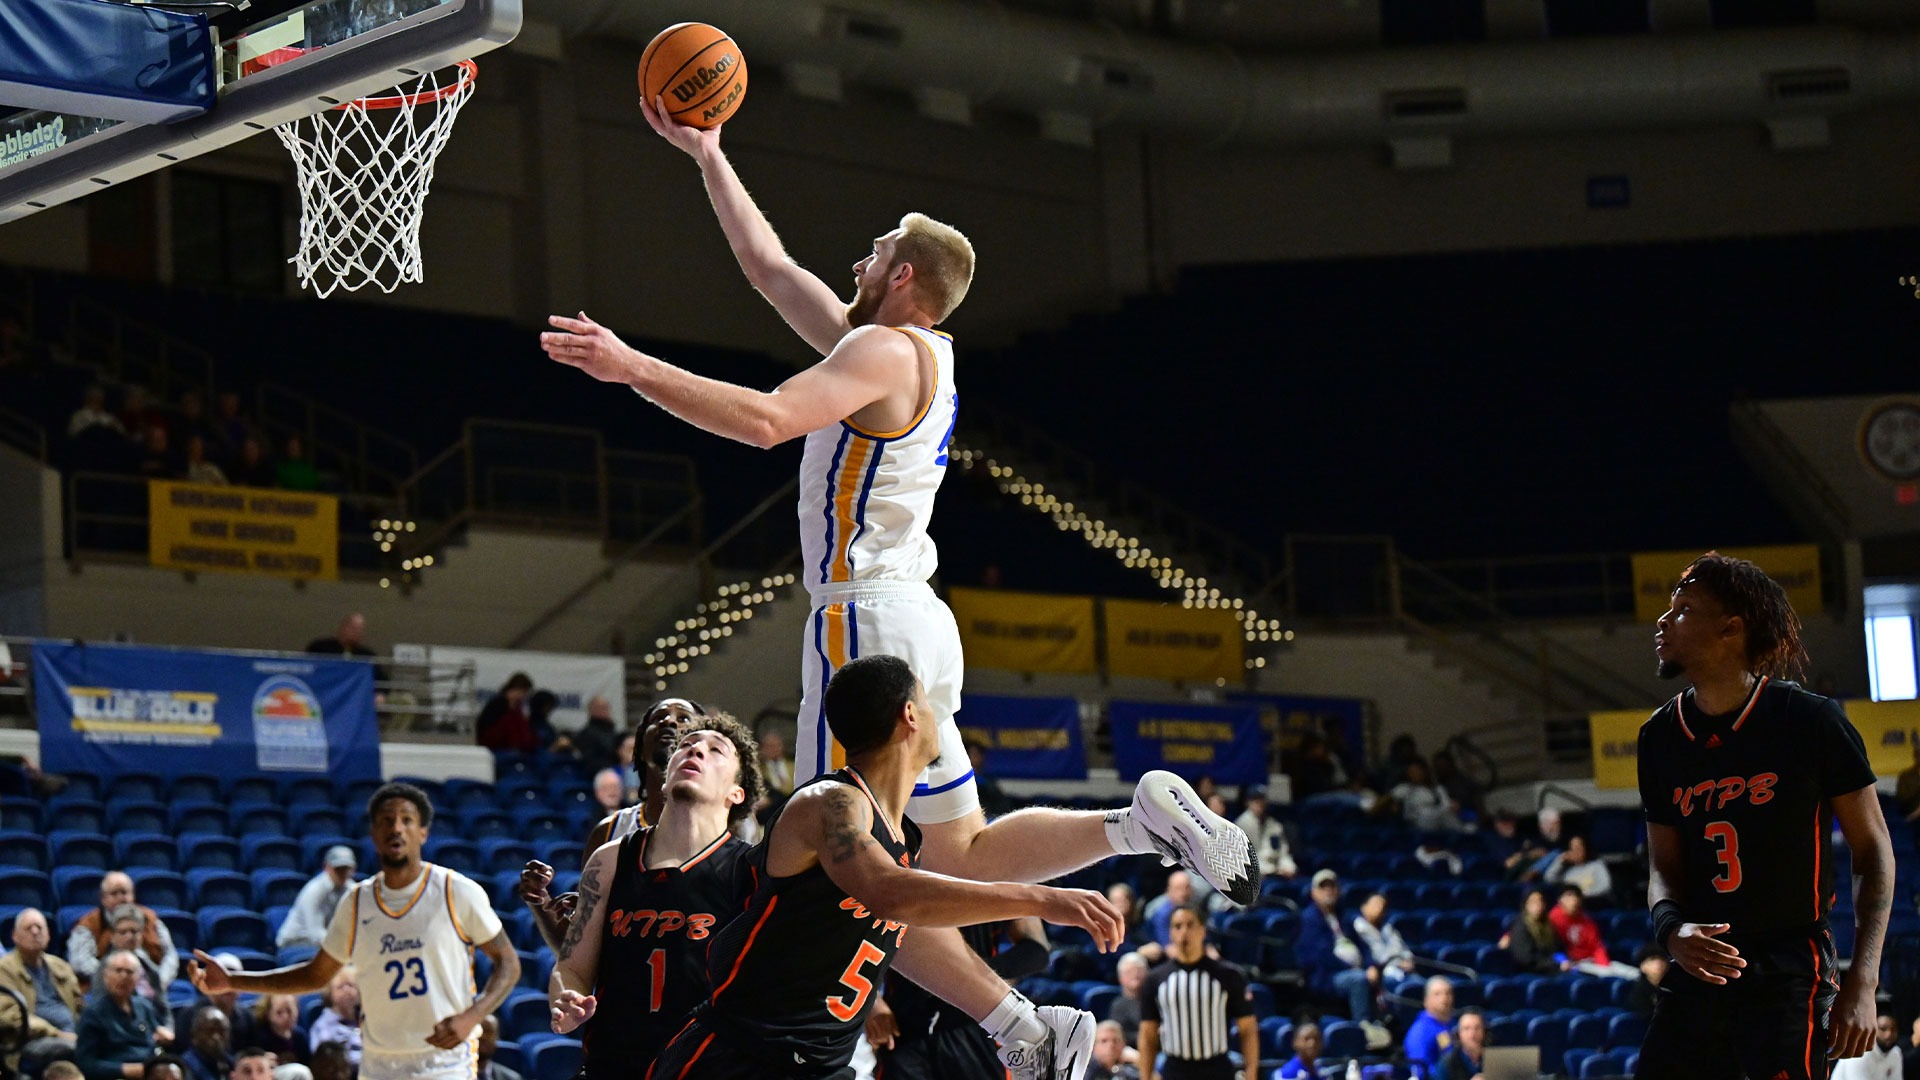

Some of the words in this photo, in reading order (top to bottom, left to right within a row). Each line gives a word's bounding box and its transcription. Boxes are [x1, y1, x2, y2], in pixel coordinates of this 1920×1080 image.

[671, 52, 736, 103] Wilson
[702, 82, 743, 122] NCAA
[1673, 772, 1779, 817] UTPB
[1703, 820, 1743, 893] 3
[379, 933, 425, 955] Rams
[610, 908, 717, 941] UTPB
[384, 956, 428, 1000] 23
[646, 948, 667, 1013] 1
[825, 939, 886, 1022] 5
